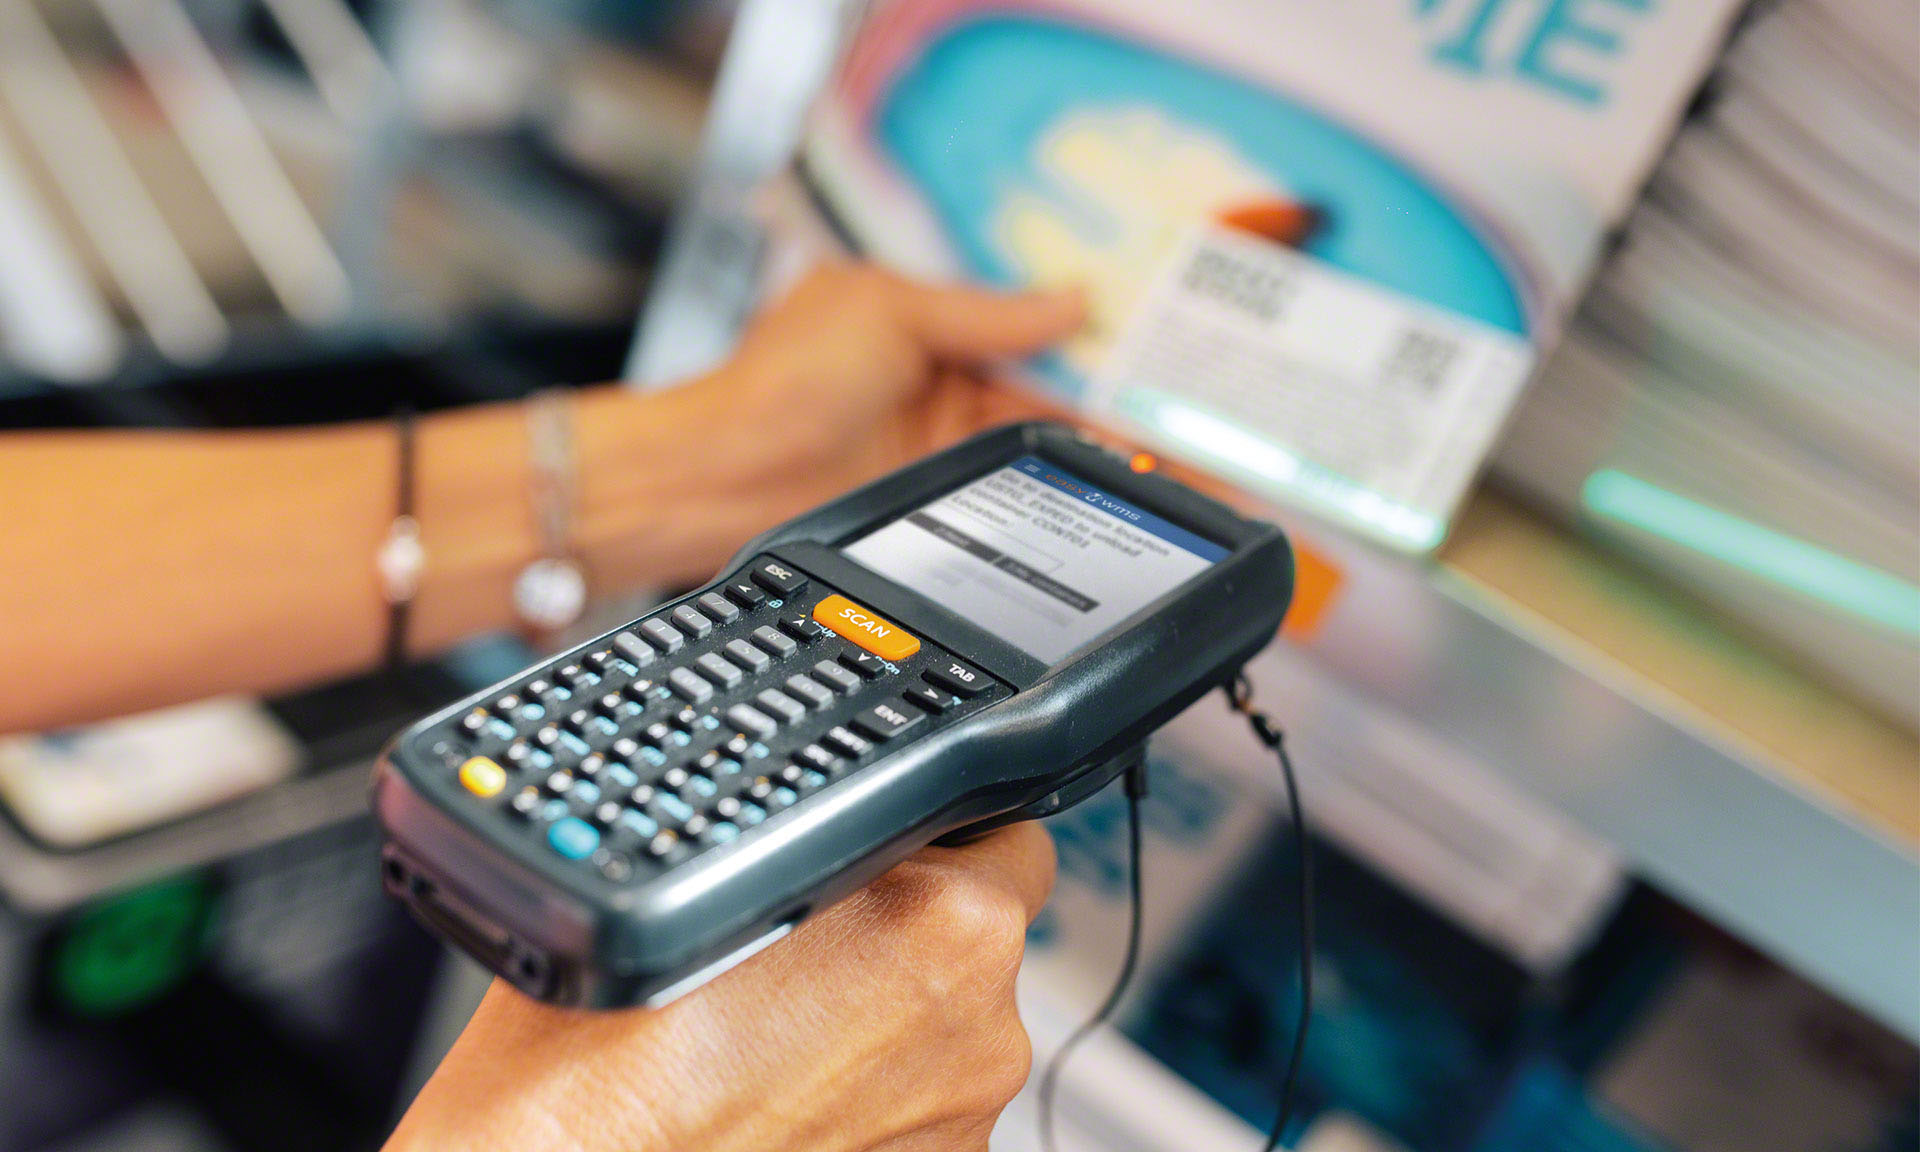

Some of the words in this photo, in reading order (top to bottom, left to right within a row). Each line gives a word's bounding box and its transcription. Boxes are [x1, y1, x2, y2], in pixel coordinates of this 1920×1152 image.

[1045, 474, 1088, 494] easy
[1102, 499, 1141, 521] wms
[1114, 526, 1170, 556] location
[765, 564, 793, 580] ESC
[838, 608, 891, 638] SCAN
[949, 663, 976, 683] TAB
[873, 704, 909, 726] ENT
